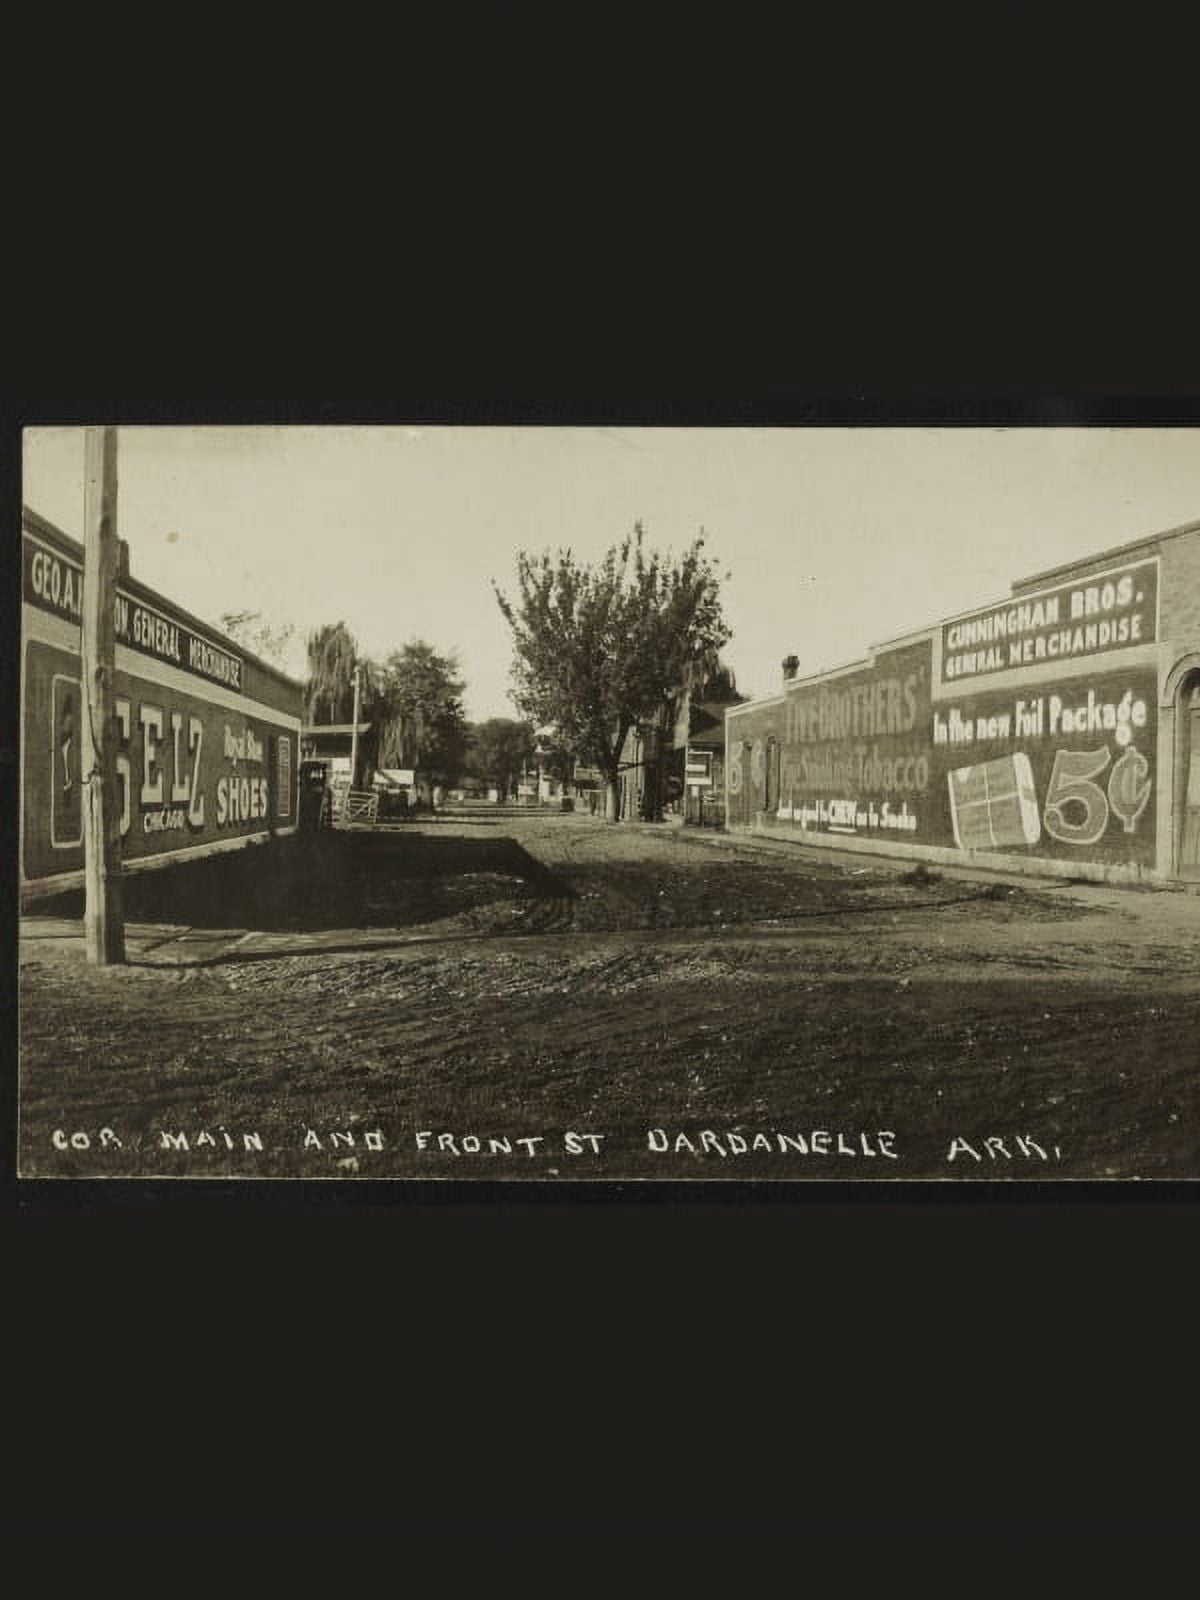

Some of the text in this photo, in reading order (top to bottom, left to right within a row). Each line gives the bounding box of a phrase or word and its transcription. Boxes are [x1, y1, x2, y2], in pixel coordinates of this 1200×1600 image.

[1070, 576, 1143, 621] BROS.
[133, 608, 180, 661] GENERAL
[945, 614, 1142, 679] GENERAL MERCHANDISE
[977, 713, 1010, 740] new
[1016, 697, 1043, 736] Foil
[1050, 689, 1146, 745] Package
[856, 743, 929, 793] Tobacco
[217, 778, 269, 824] SHOES
